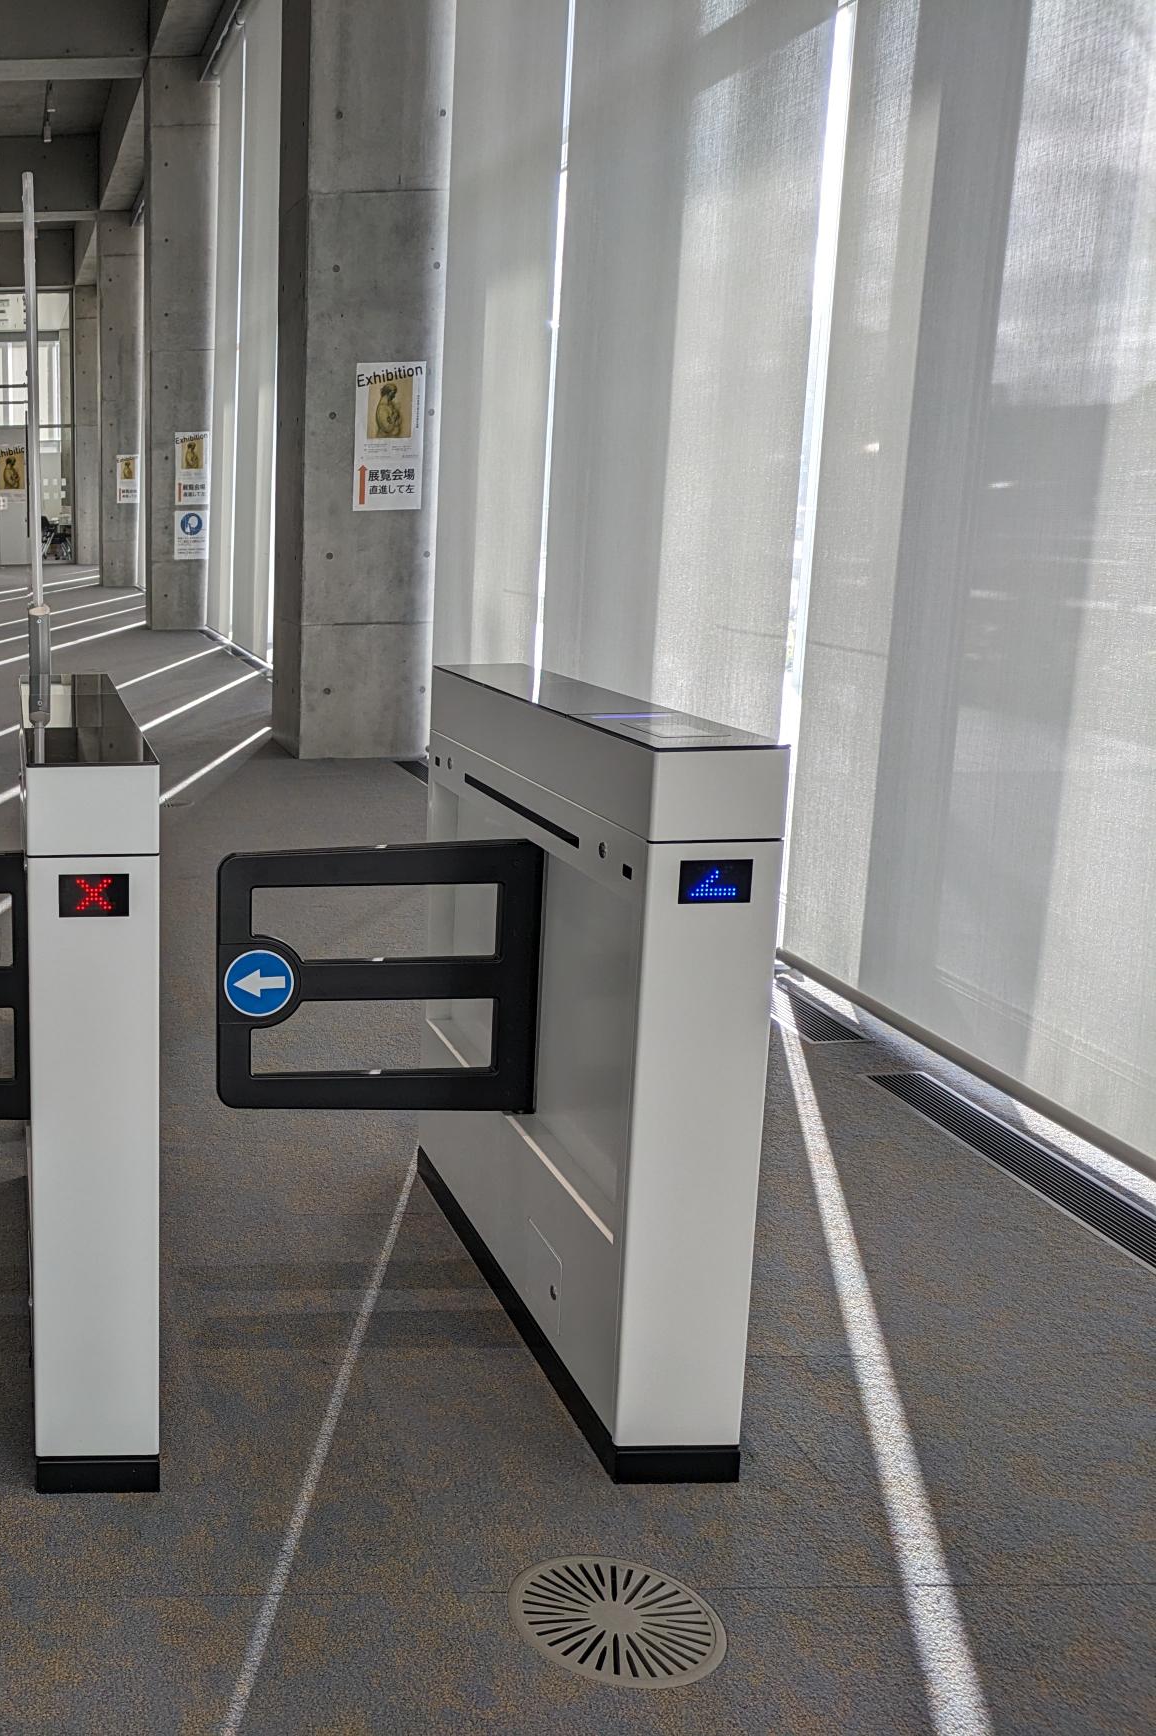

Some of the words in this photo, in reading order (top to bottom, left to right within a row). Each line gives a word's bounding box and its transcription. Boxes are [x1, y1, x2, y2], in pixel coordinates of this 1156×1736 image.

[356, 365, 423, 388] Exhibition
[175, 433, 208, 445] Exhibition
[367, 468, 415, 482] 展覧会場
[368, 484, 415, 495] 直進して左
